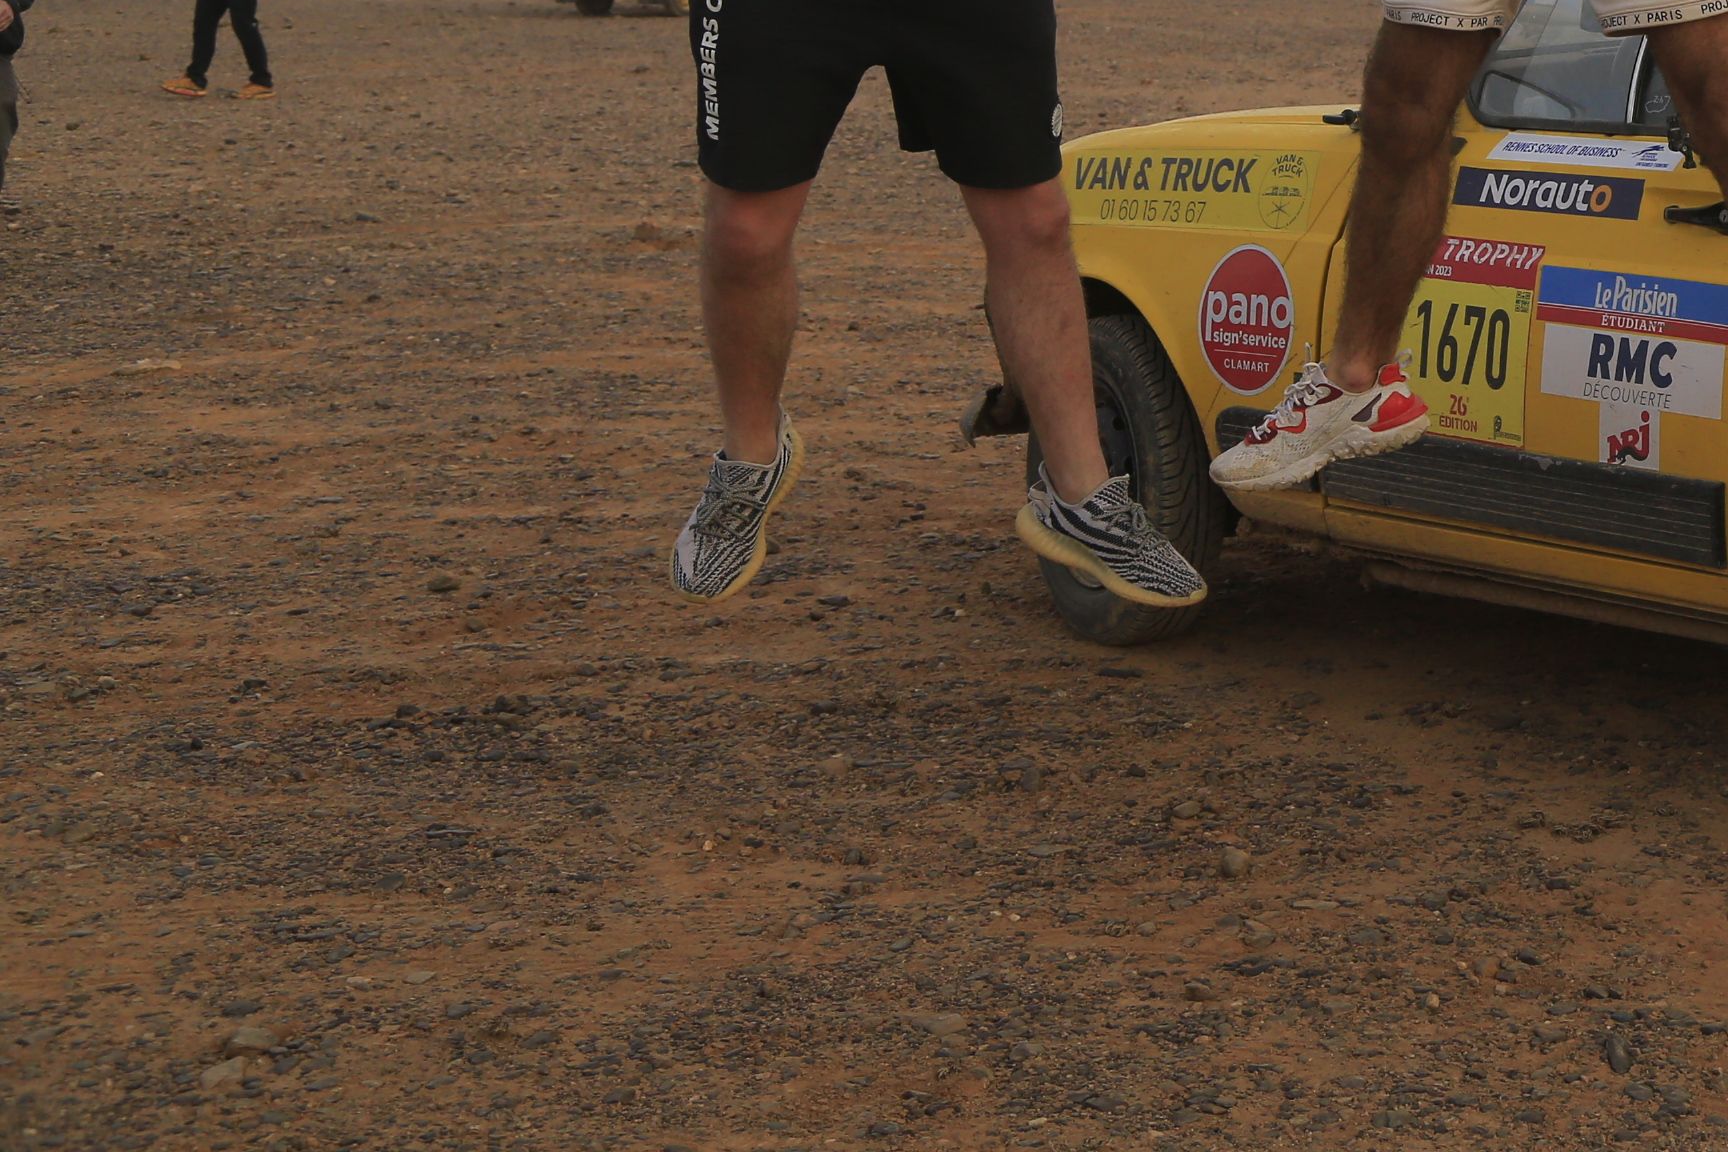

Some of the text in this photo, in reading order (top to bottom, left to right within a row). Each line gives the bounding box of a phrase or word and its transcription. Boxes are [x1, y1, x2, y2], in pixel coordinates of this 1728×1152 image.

[1410, 12, 1450, 26] PROJECT
[1456, 18, 1464, 28] X
[1634, 14, 1641, 24] X
[1647, 9, 1683, 23] PARIS
[701, 17, 720, 141] MEMBERS
[1276, 154, 1297, 165] VAN
[1502, 141, 1622, 158] RENNES SCHOOL OF BUSINESS
[1075, 157, 1258, 193] VAN & TRUCK
[1272, 164, 1303, 177] TRUCK
[1478, 173, 1613, 213] Norauto
[1100, 198, 1207, 224] 01 60 15 73 67
[1443, 238, 1544, 270] TROPHY
[1435, 264, 1452, 277] 2023
[1594, 275, 1678, 317] Le Parisien
[1205, 290, 1293, 342] pano
[1601, 313, 1666, 334] ÉTUDIANT
[1213, 328, 1286, 349] sign'service
[1417, 300, 1510, 390] 1670
[1223, 358, 1270, 373] CLAMART
[1587, 333, 1678, 389] RMC
[1583, 380, 1672, 409] DÉCOUVERTE
[1439, 415, 1478, 433] EDITION
